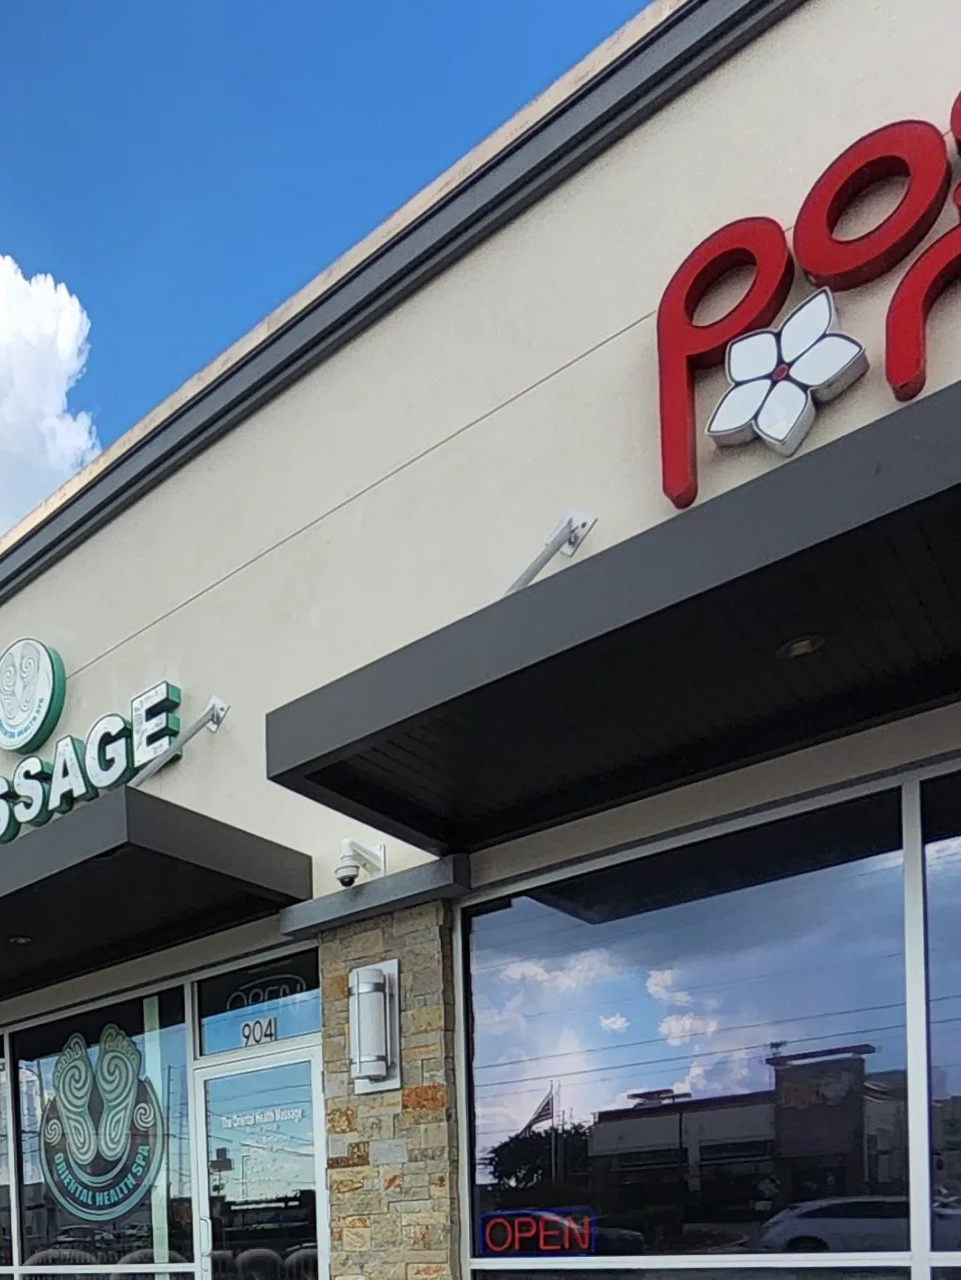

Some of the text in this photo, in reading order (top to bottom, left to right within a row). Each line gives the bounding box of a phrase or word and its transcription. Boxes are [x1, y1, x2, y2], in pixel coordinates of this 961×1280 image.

[241, 1018, 275, 1048] 904
[54, 1145, 151, 1206] ORIENTAL HEALTH SPA
[484, 1215, 590, 1252] OPEN
